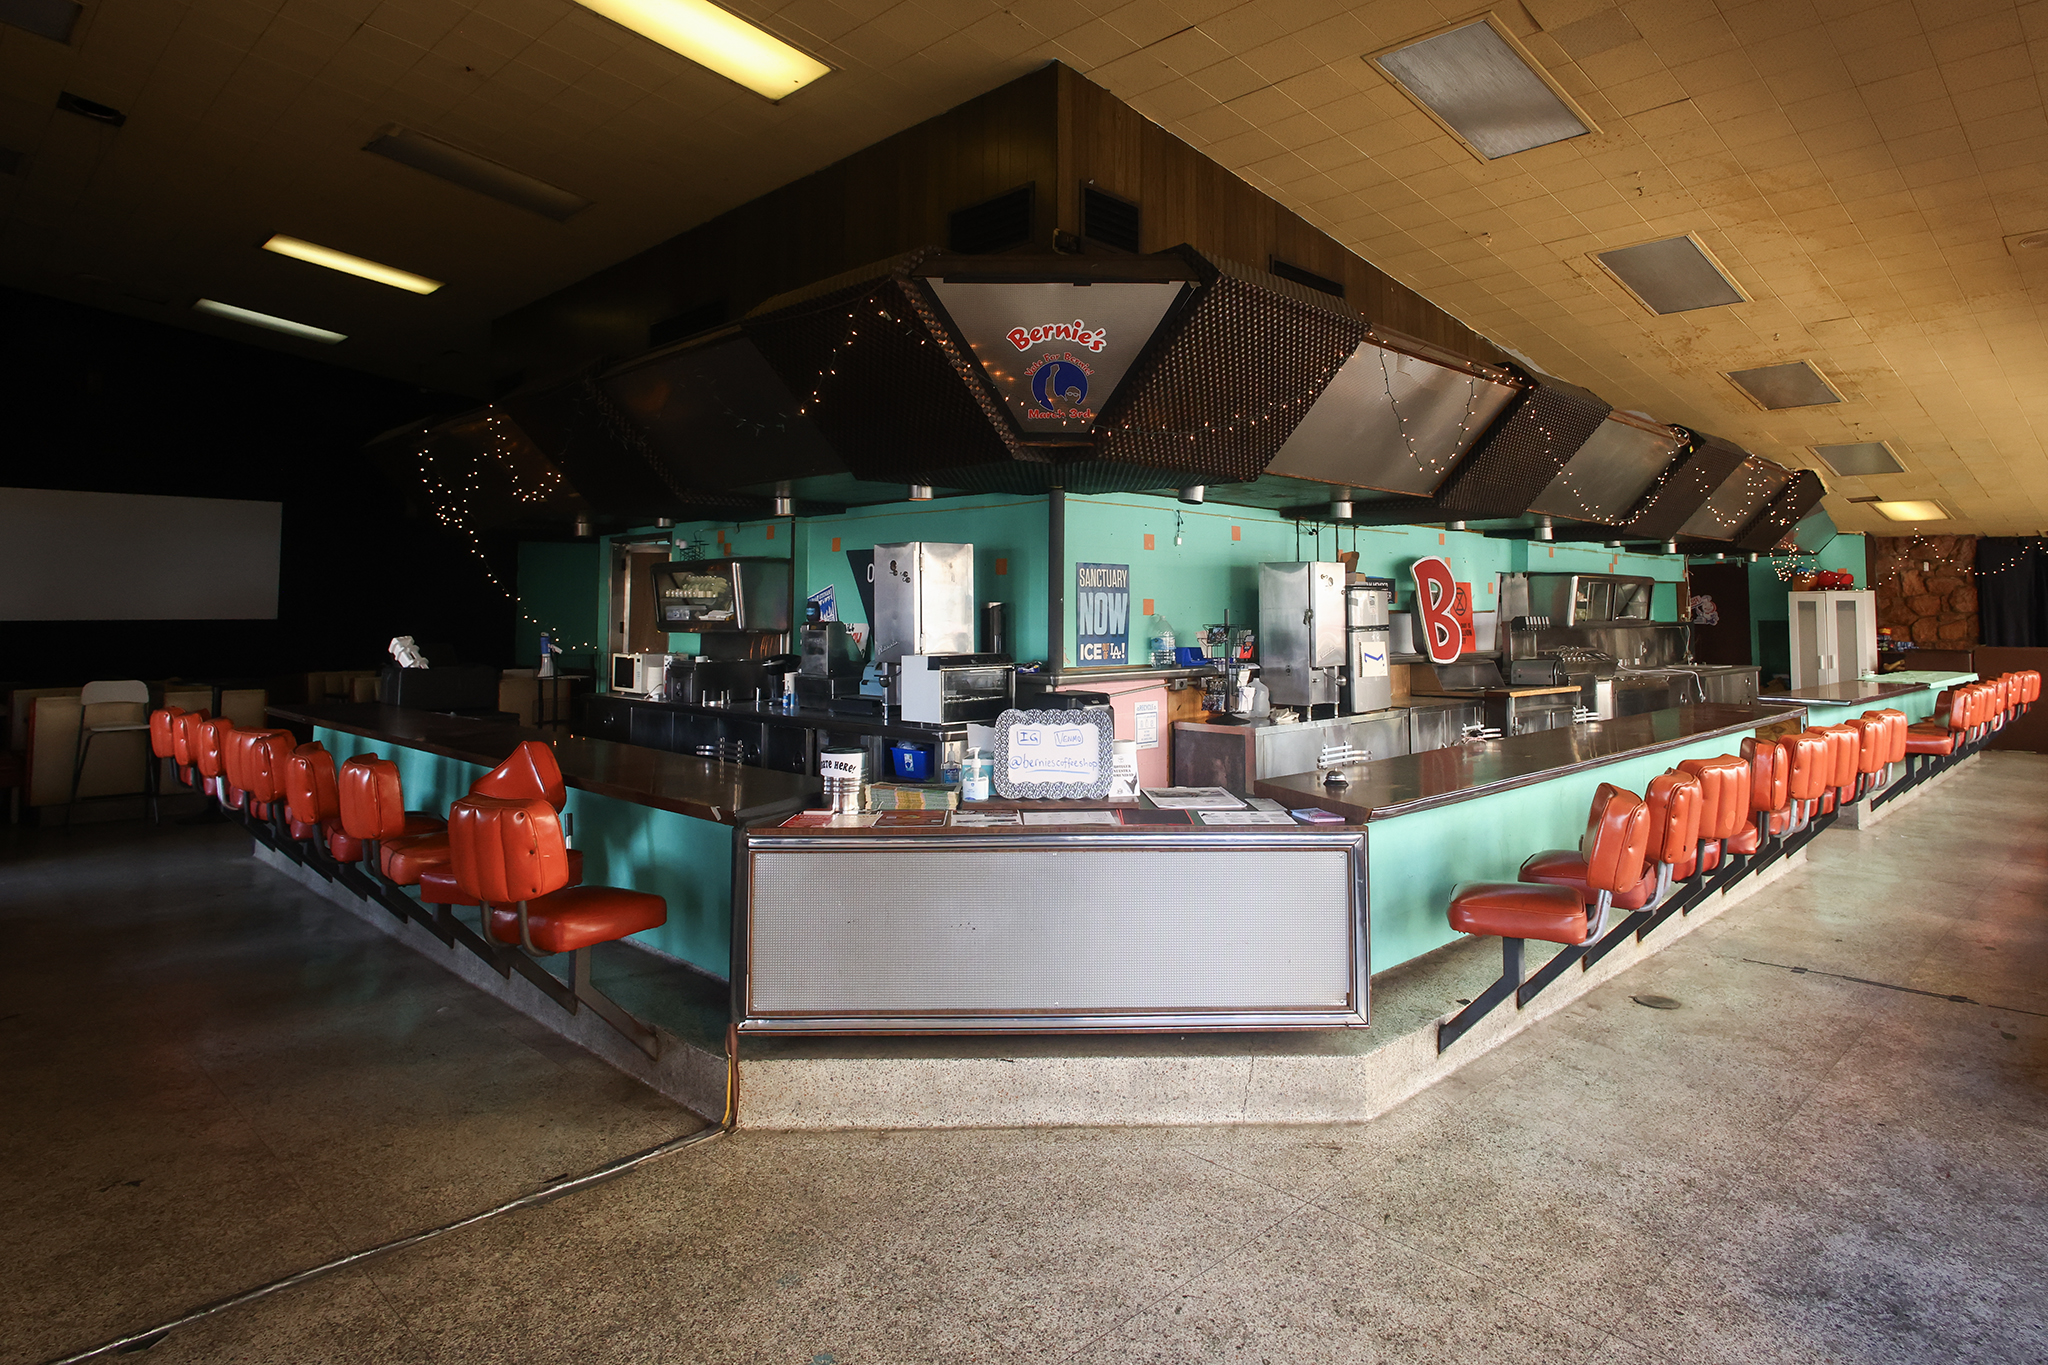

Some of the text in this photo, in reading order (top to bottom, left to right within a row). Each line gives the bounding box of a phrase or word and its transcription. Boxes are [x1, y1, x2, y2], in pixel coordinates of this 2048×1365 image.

[1006, 319, 1107, 352] Bernie's
[1024, 352, 1095, 376] Vote For Bernie!
[1028, 408, 1091, 419] March 3rd
[1079, 568, 1127, 588] SANCTUARY
[1080, 592, 1128, 636] NOW
[1410, 555, 1462, 664] B
[1080, 643, 1102, 660] ICE
[1020, 731, 1081, 744] IG VENMO
[1009, 753, 1098, 771] @berniescoffeeshop
